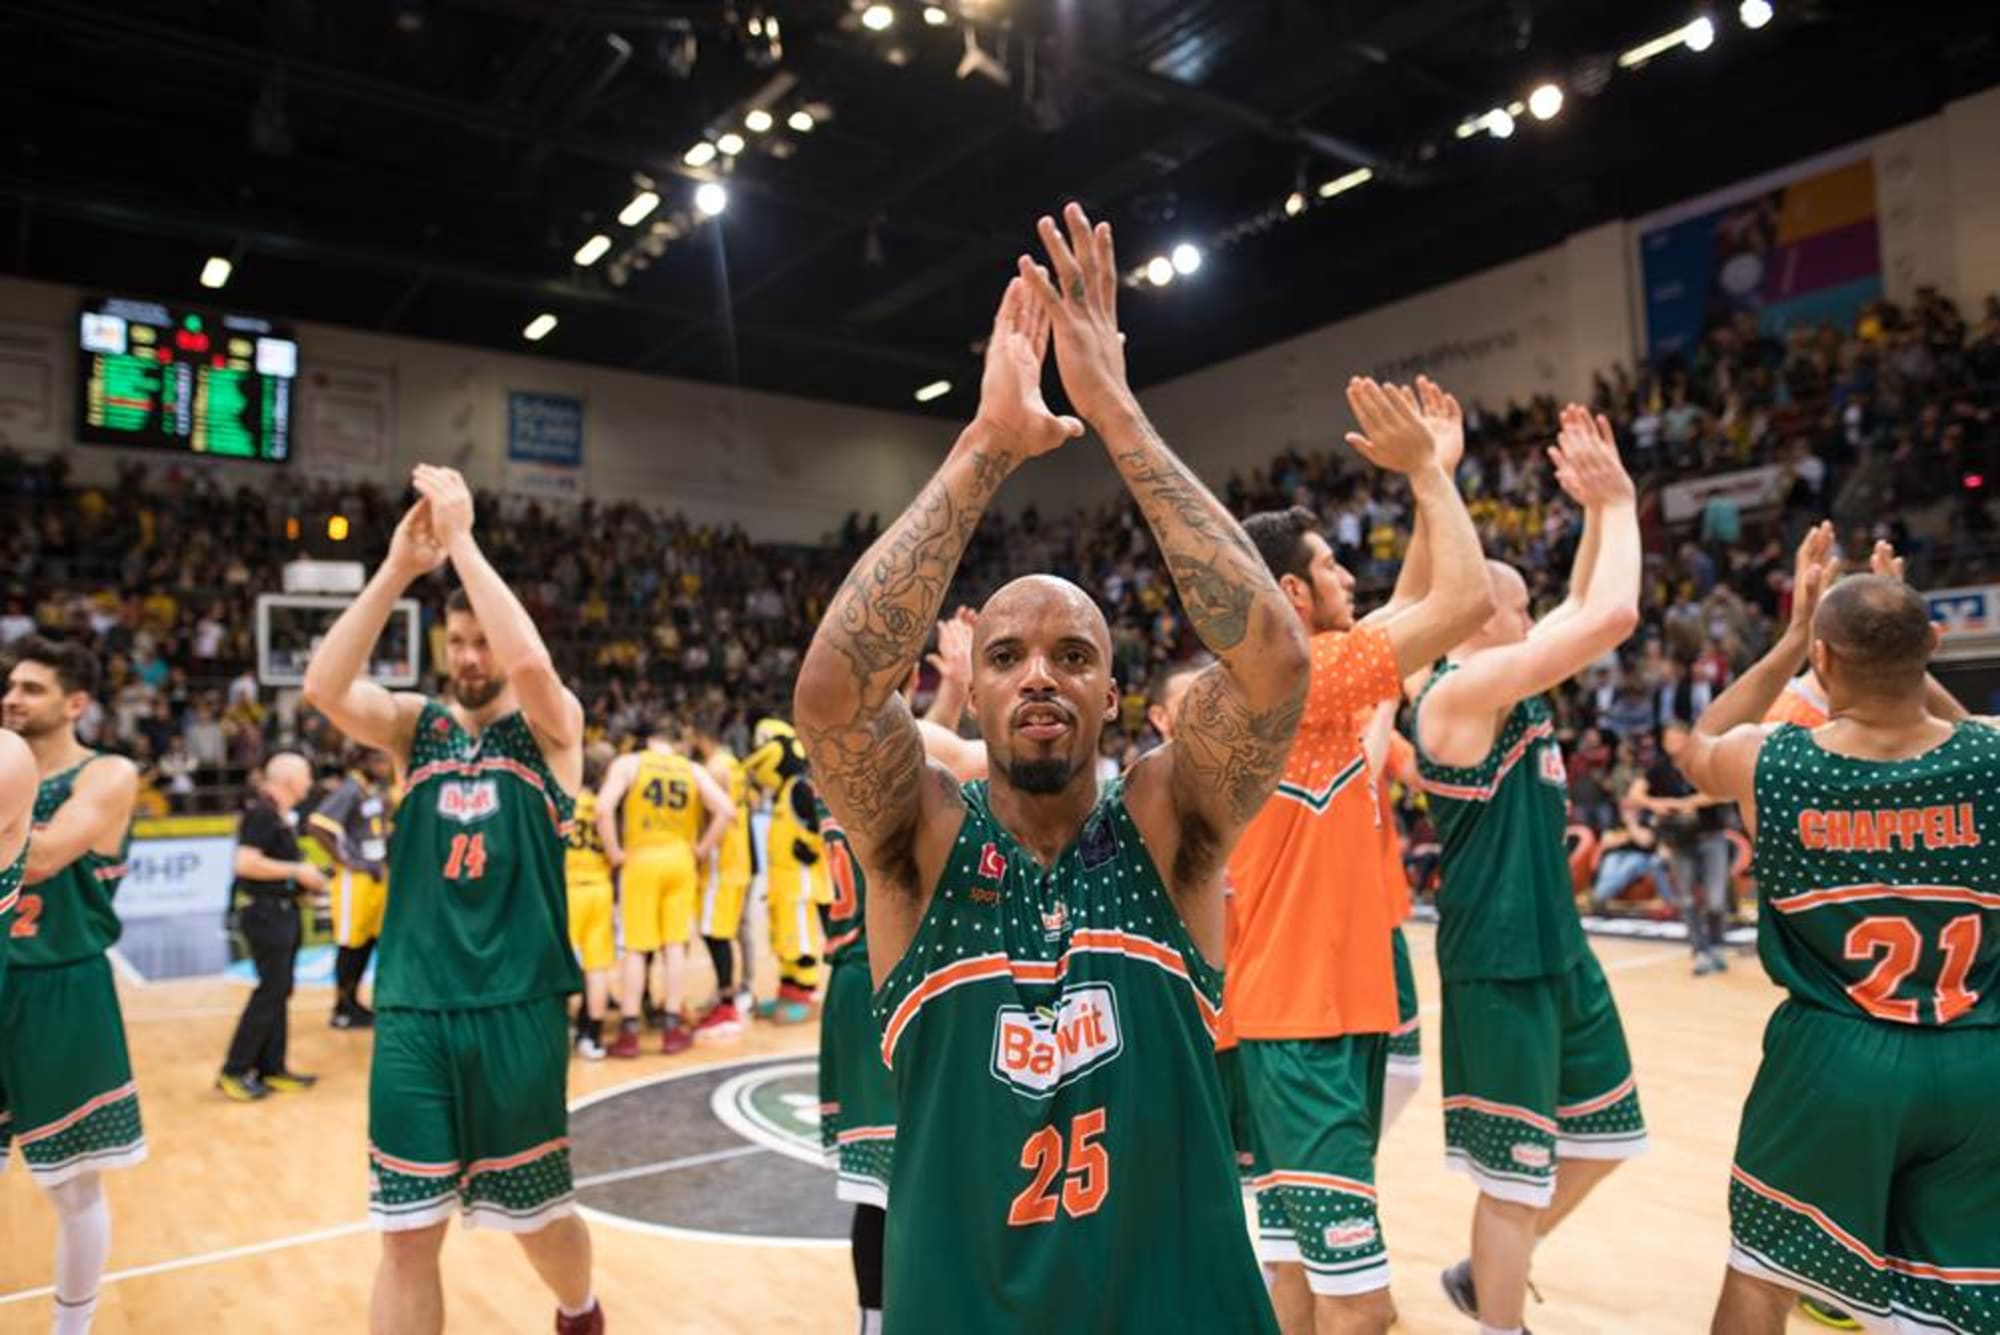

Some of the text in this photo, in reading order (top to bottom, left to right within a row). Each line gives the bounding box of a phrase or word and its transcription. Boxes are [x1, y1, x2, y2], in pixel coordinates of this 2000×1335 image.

[643, 778, 688, 811] 45
[1798, 802, 1981, 852] CHAPPELL
[443, 832, 487, 880] 14
[1844, 912, 1982, 1024] 21
[1007, 1106, 1110, 1226] 25
